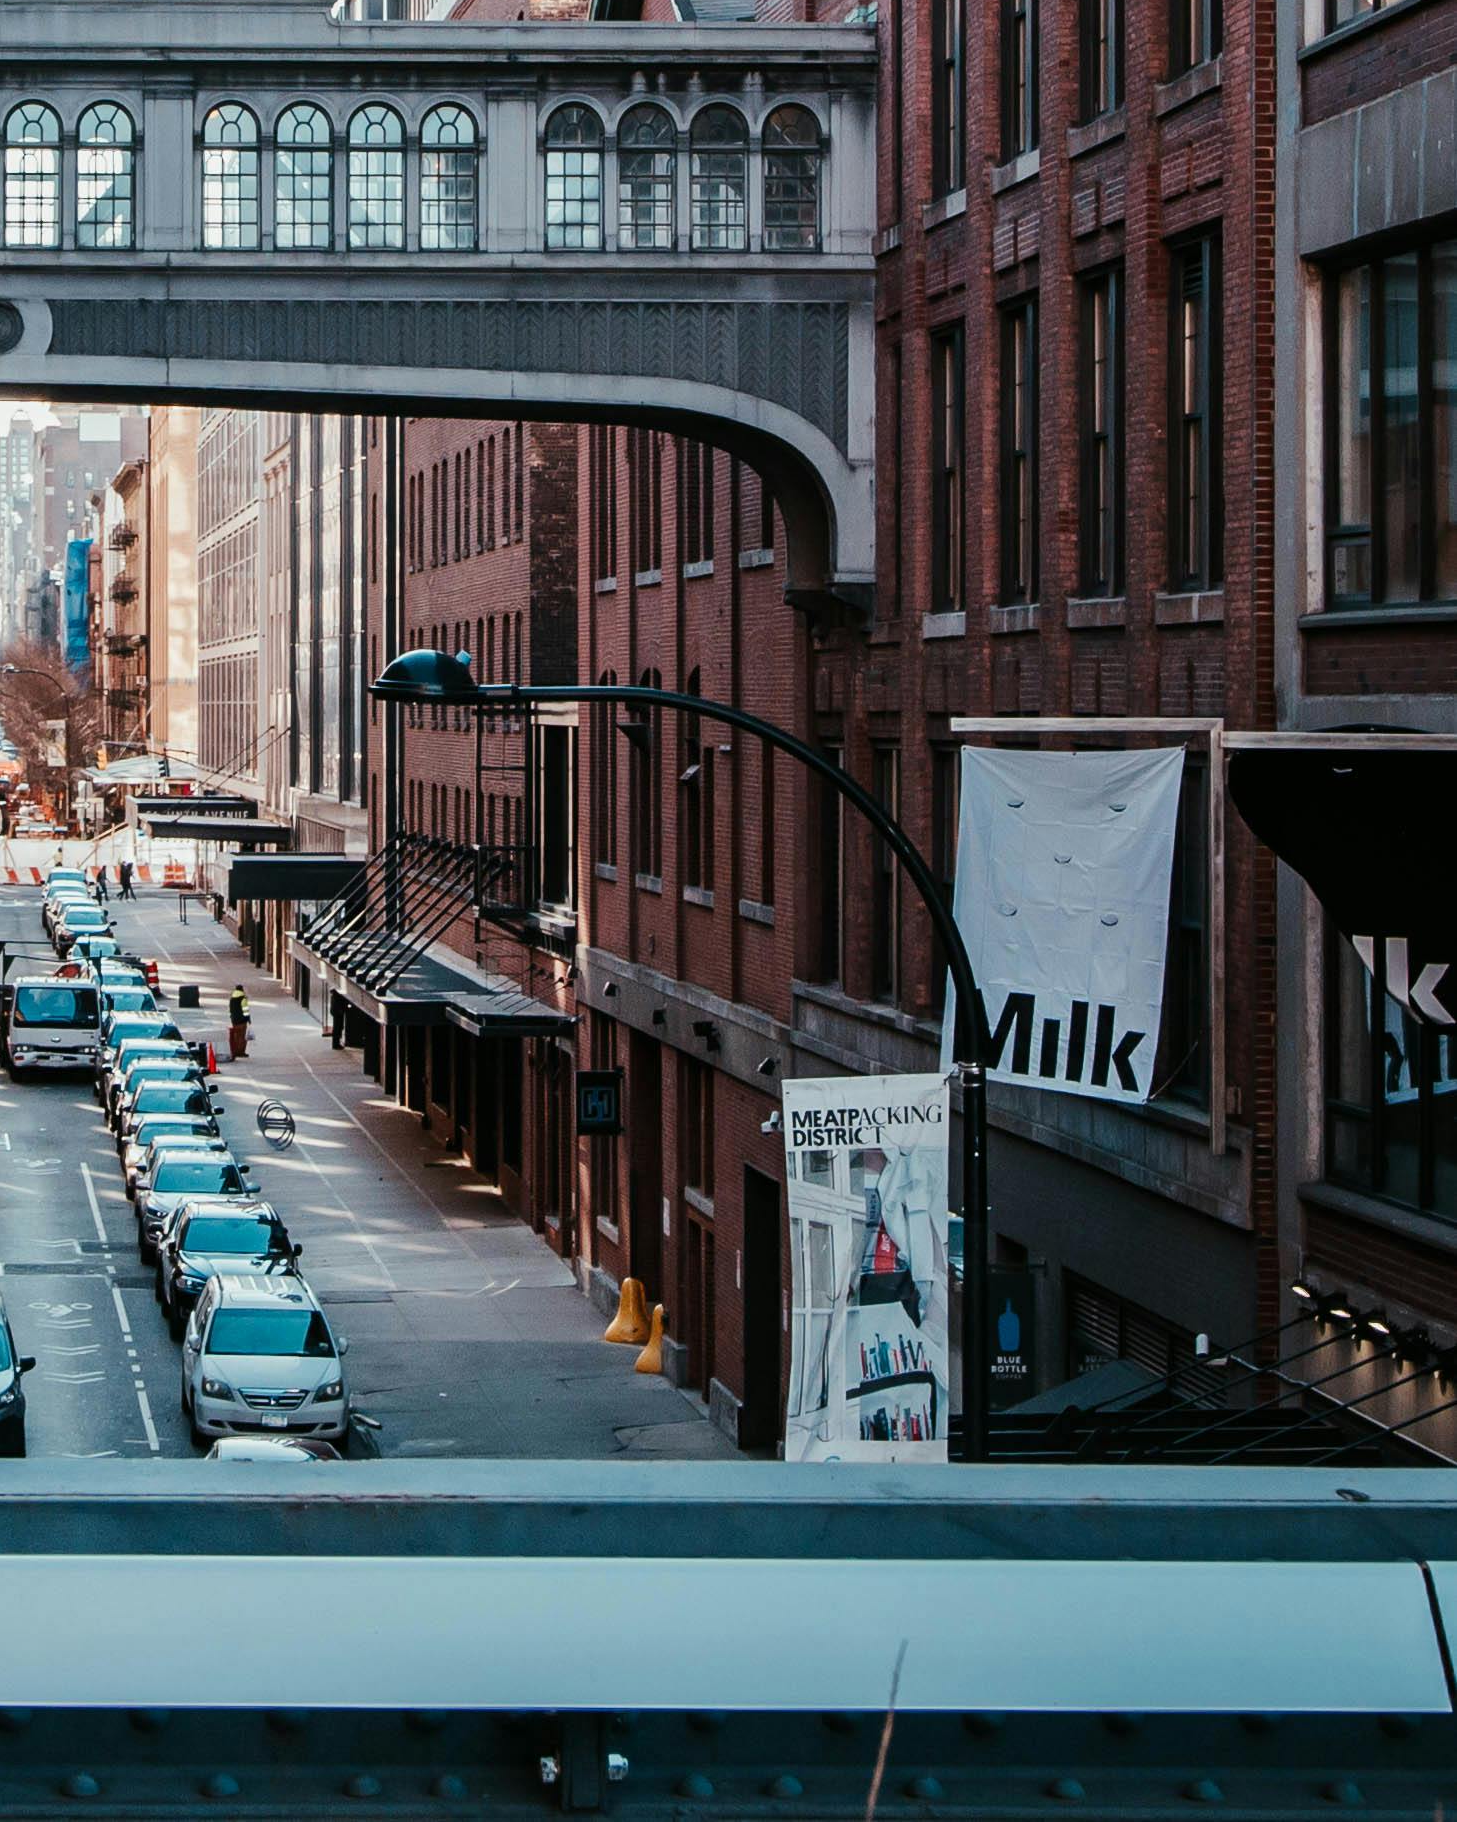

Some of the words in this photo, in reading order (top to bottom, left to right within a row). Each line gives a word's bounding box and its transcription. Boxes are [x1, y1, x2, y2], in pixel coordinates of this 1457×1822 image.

[952, 988, 1146, 1093] Milk
[792, 1104, 942, 1128] MEATPACKING
[793, 1126, 885, 1147] DISTRICT
[990, 1365, 1027, 1373] BOTTLE
[997, 1356, 1021, 1364] BLUE
